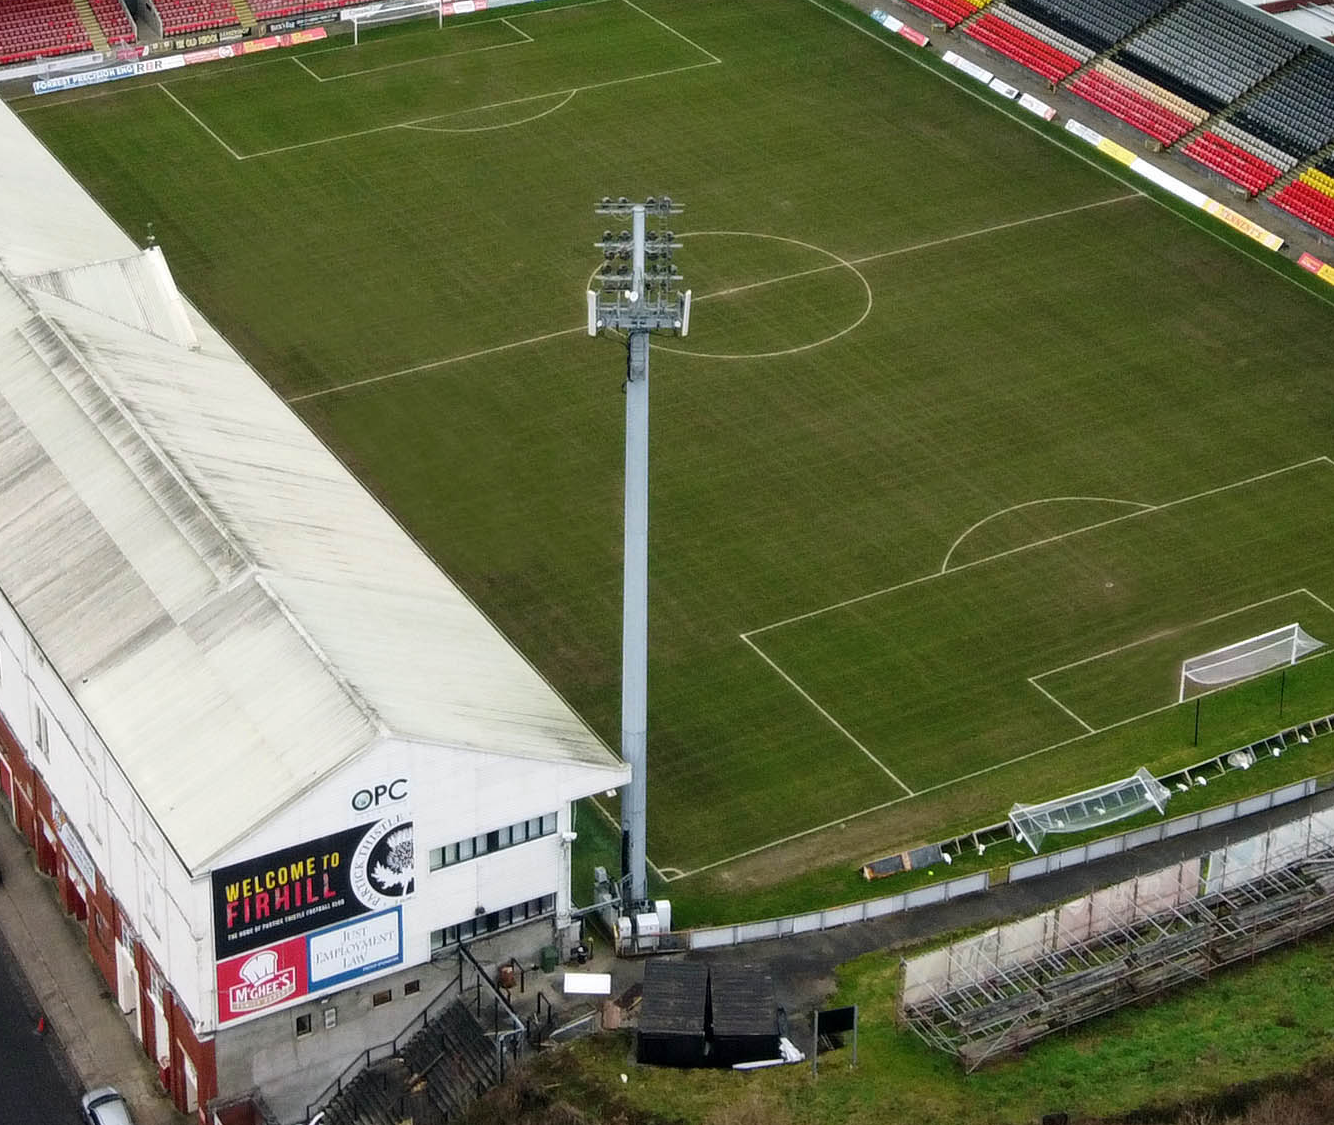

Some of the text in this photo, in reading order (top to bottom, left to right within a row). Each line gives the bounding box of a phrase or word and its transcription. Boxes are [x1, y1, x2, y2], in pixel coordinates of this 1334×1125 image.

[35, 77, 71, 91] FORREST
[351, 779, 408, 810] OPC
[225, 852, 340, 903] WELCOME TO
[354, 861, 380, 907] PARTICK
[226, 873, 336, 928] FIRHILL
[316, 930, 396, 964] EMPLOYMENT
[343, 926, 369, 943] JUST
[343, 954, 367, 969] LAW
